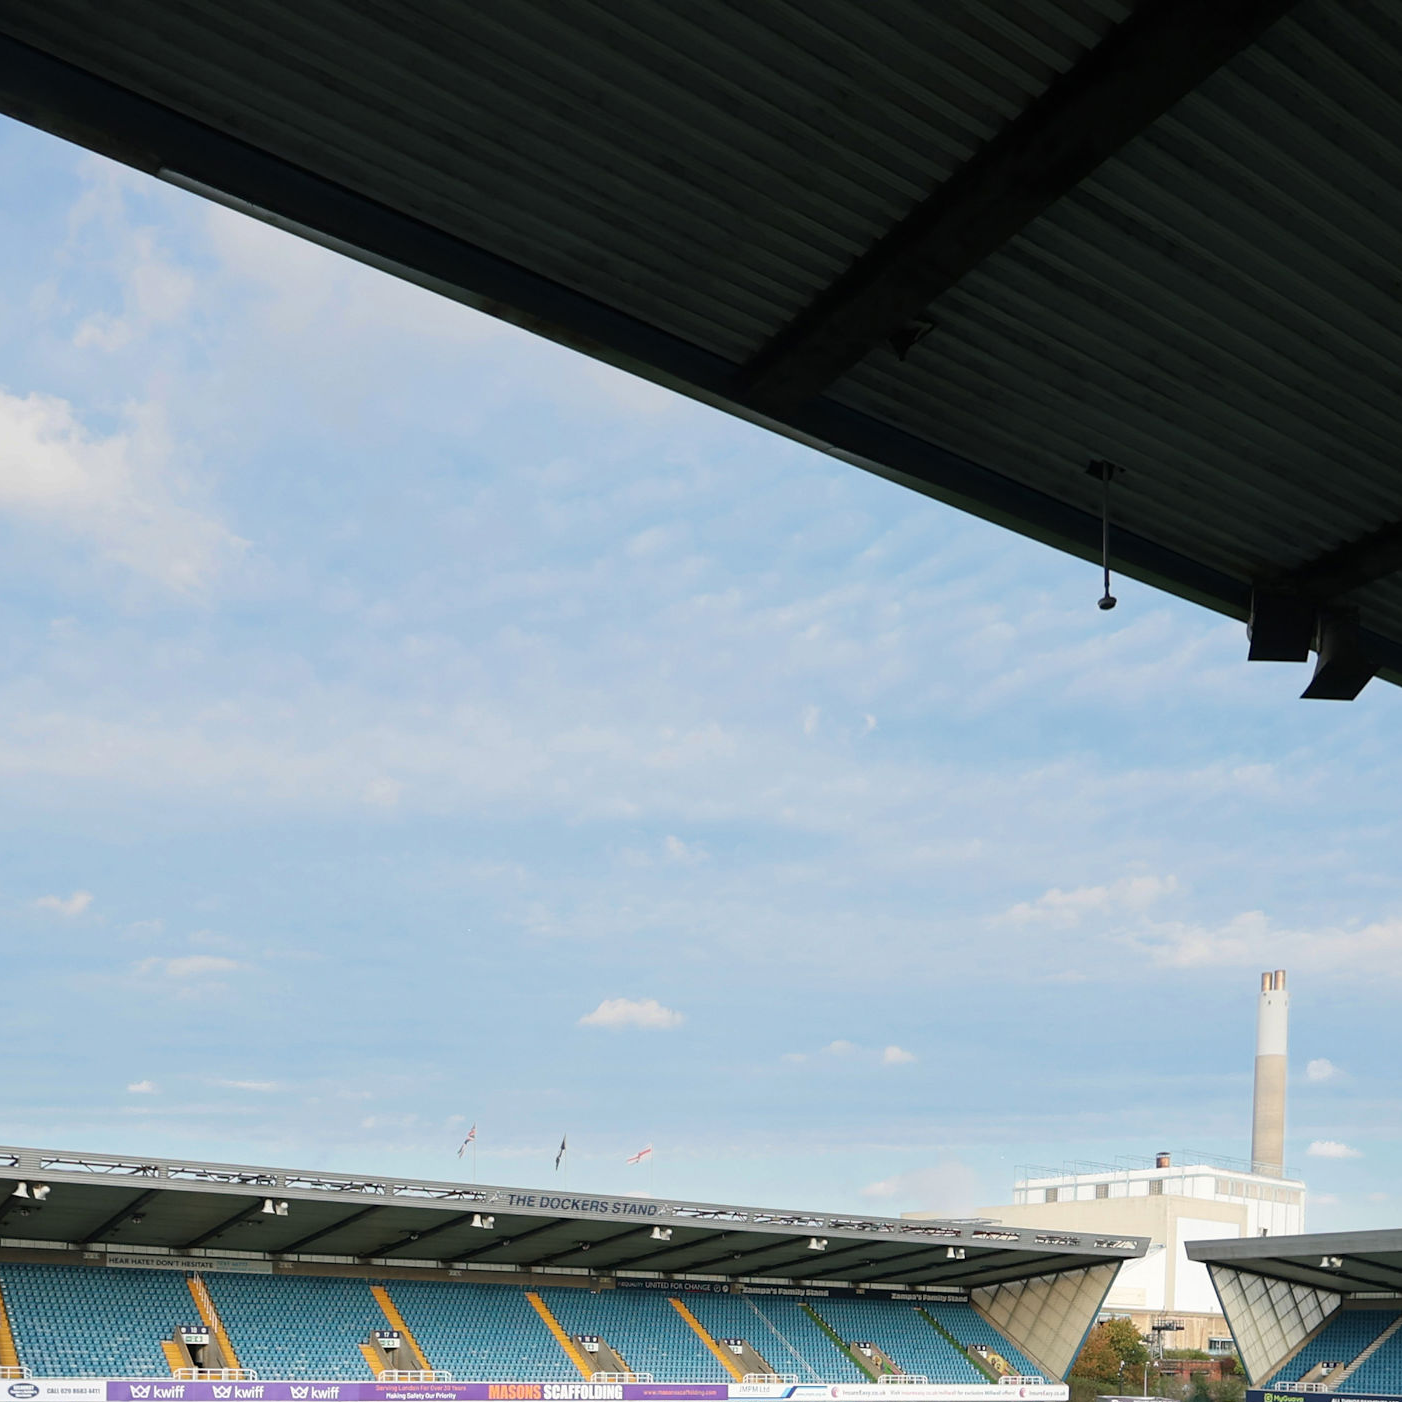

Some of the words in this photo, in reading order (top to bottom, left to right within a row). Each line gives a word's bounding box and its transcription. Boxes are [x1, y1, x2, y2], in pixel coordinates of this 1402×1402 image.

[508, 1195, 535, 1207] THE
[540, 1197, 608, 1212] DOCKERS
[612, 1203, 658, 1215] STAND
[110, 1257, 130, 1265] HEAR
[805, 1288, 829, 1296] Stand
[947, 1294, 968, 1302] Stand
[154, 1385, 185, 1398] kwiff
[235, 1385, 265, 1398] kwiff
[311, 1386, 340, 1399] kwiff
[489, 1385, 542, 1399] MASONS
[543, 1385, 623, 1400] SCAFFOLDING
